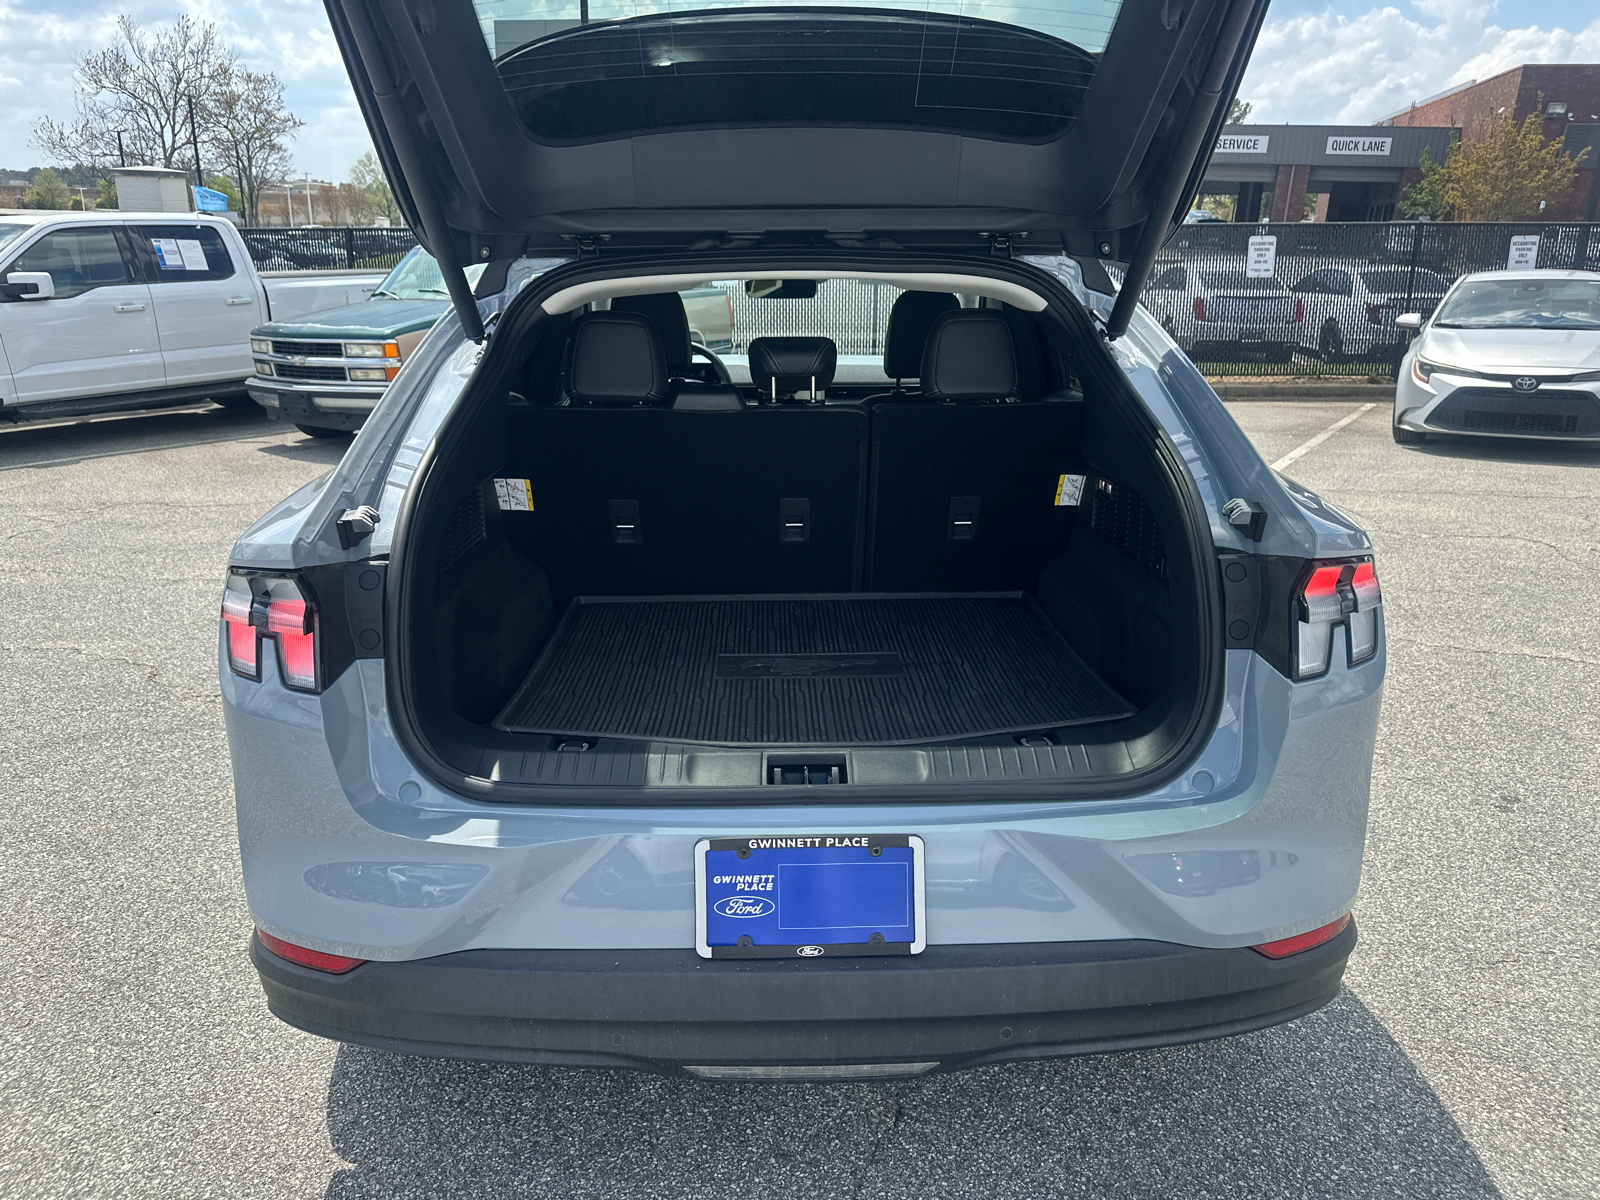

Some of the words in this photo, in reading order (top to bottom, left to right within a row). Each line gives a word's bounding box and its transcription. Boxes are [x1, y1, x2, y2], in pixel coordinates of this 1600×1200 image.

[1216, 138, 1259, 150] SERVICE
[1331, 139, 1360, 151] QUICK
[1361, 140, 1386, 152] LANE
[748, 838, 821, 849] GWINNETT
[826, 837, 869, 847] PLACE
[713, 875, 775, 884] GWINNETT
[736, 883, 774, 891] PLACE
[725, 898, 764, 914] Ford
